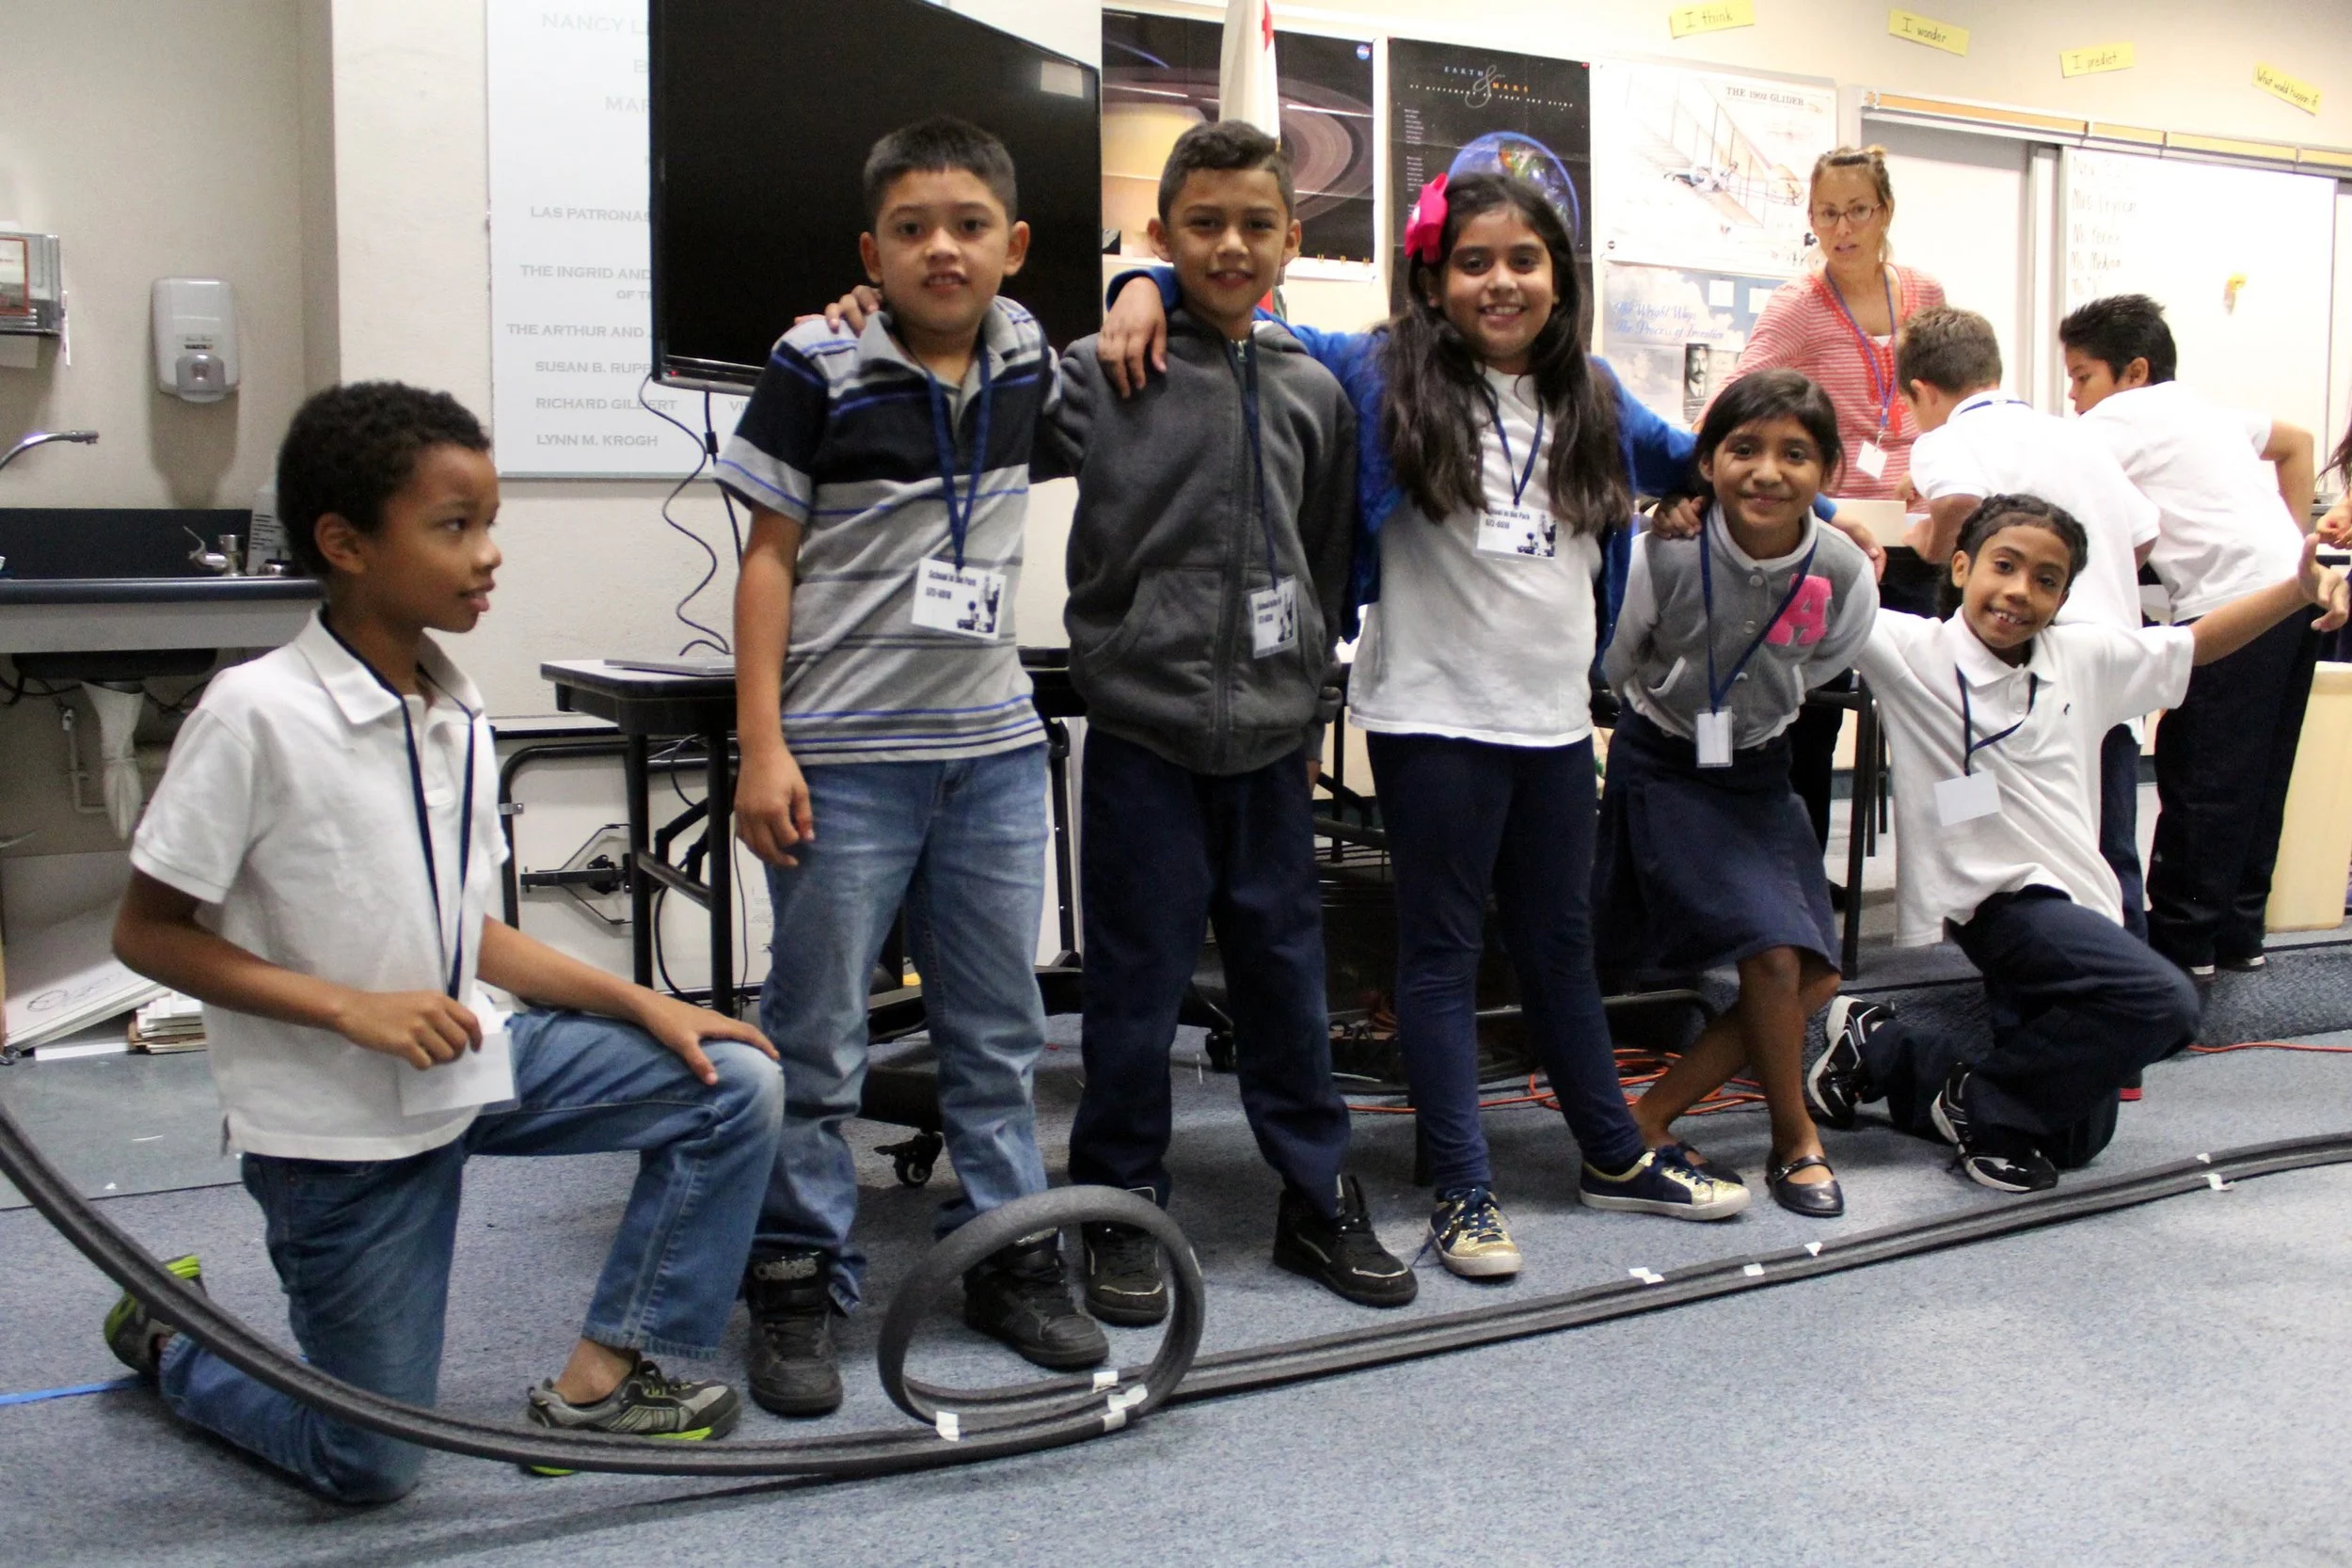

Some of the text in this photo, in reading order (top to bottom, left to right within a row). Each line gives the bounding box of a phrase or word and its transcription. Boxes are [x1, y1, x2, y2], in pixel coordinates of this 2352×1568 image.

[542, 13, 624, 32] NANCY
[1685, 7, 1733, 28] I think
[1900, 16, 1947, 43] I wonder
[2071, 51, 2118, 71] I predict
[1444, 66, 1484, 76] EARTH
[1492, 82, 1530, 93] MARS
[1726, 86, 1804, 106] THE 1902 GLIDER
[531, 206, 562, 218] LAS
[520, 264, 651, 280] THE INGRID AND
[616, 290, 634, 300] OF
[506, 324, 538, 336] THE
[541, 325, 606, 337] ARTHUR
[611, 326, 644, 337] AND
[535, 361, 588, 372] SUSAN
[592, 362, 606, 373] B.
[535, 398, 606, 409] RICHARD
[537, 435, 658, 447] LYNN M. KROGH
[1764, 572, 1833, 646] A
